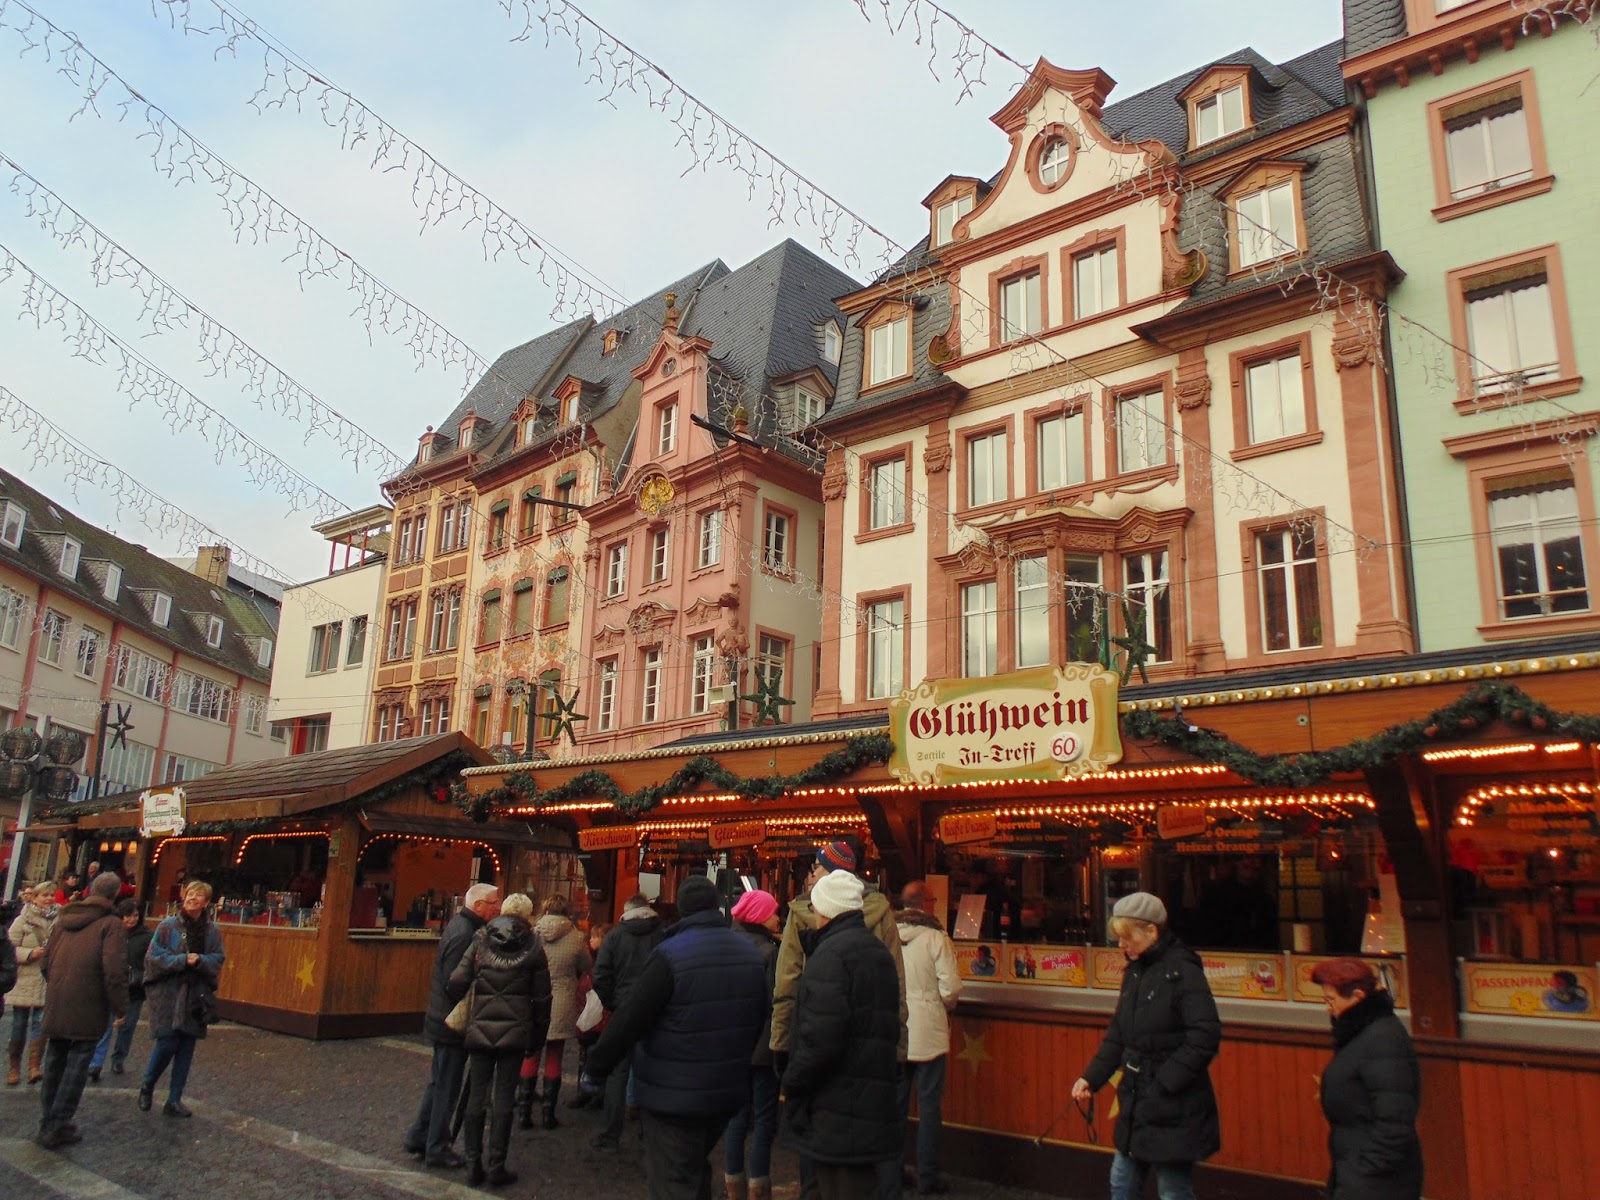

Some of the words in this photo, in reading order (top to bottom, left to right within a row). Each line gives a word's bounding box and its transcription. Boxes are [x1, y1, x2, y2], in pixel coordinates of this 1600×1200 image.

[909, 692, 1092, 743] Glühwein
[958, 742, 1036, 766] In-Treff
[1052, 737, 1076, 756] 60
[997, 820, 1041, 830] beerwein
[583, 830, 632, 847] Kirschwein
[714, 827, 760, 845] Glühwein
[1475, 977, 1555, 989] TASSENPFAN
